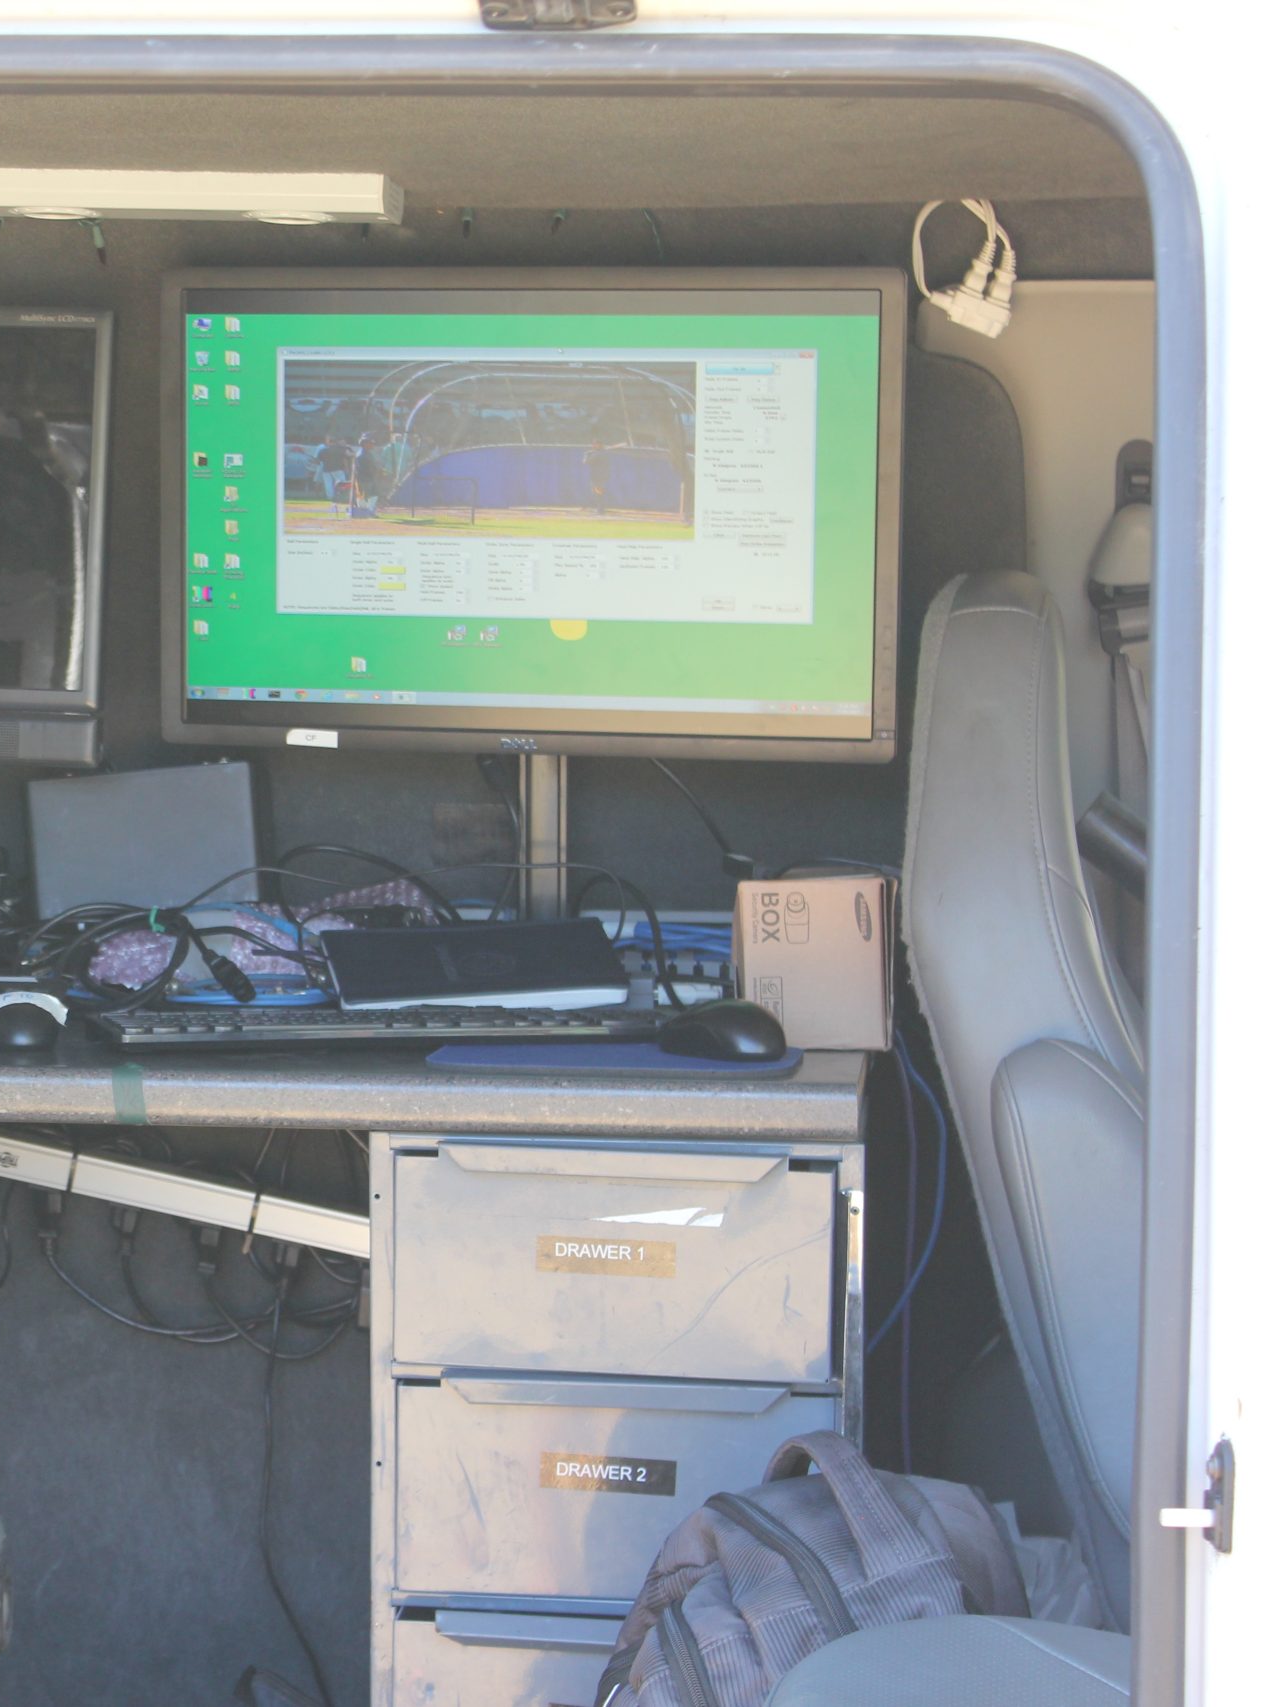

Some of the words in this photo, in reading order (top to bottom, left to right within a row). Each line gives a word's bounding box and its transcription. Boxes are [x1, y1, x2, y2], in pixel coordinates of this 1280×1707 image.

[761, 892, 780, 943] BOX
[555, 1242, 631, 1260] DRAWER
[637, 1247, 645, 1261] 1
[556, 1461, 632, 1481] DRAWER
[636, 1467, 647, 1482] 2
